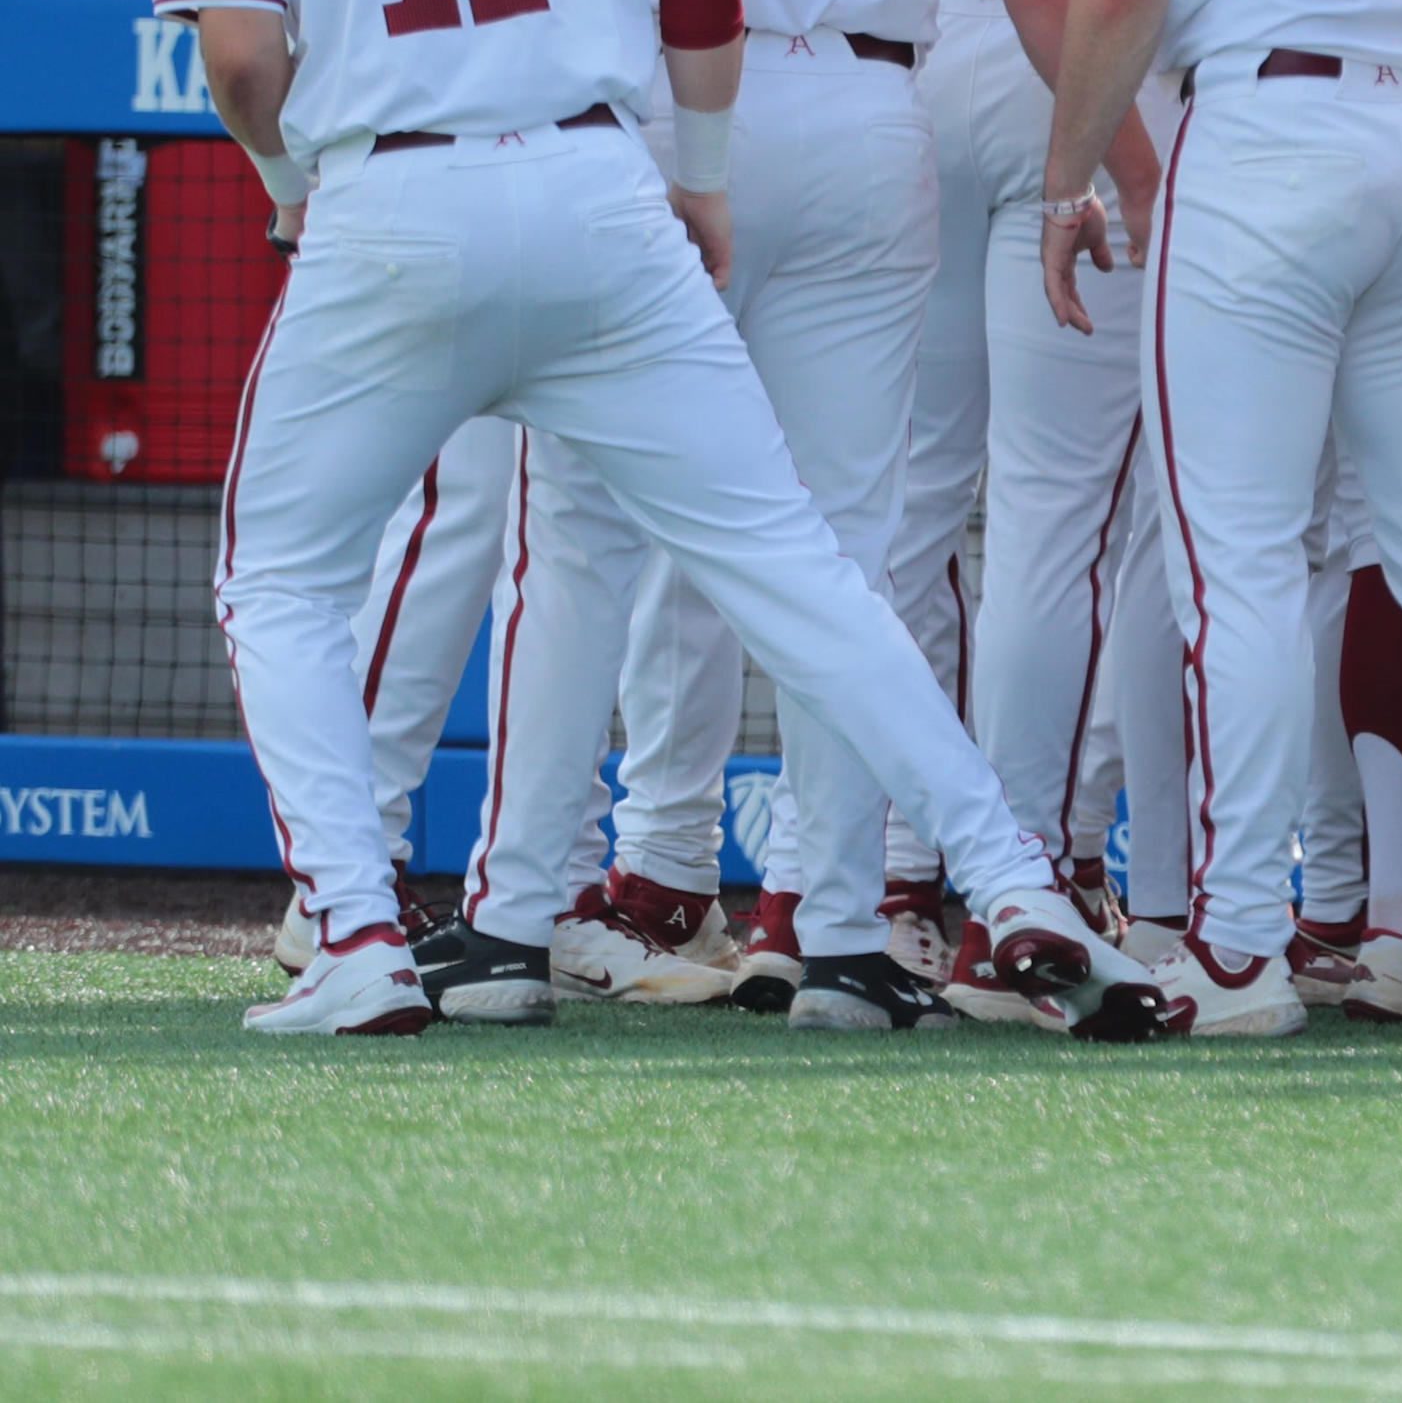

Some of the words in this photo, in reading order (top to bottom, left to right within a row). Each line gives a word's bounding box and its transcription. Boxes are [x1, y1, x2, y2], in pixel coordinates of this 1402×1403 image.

[784, 35, 816, 57] A
[0, 787, 154, 838] YSTEM
[664, 904, 688, 930] A
